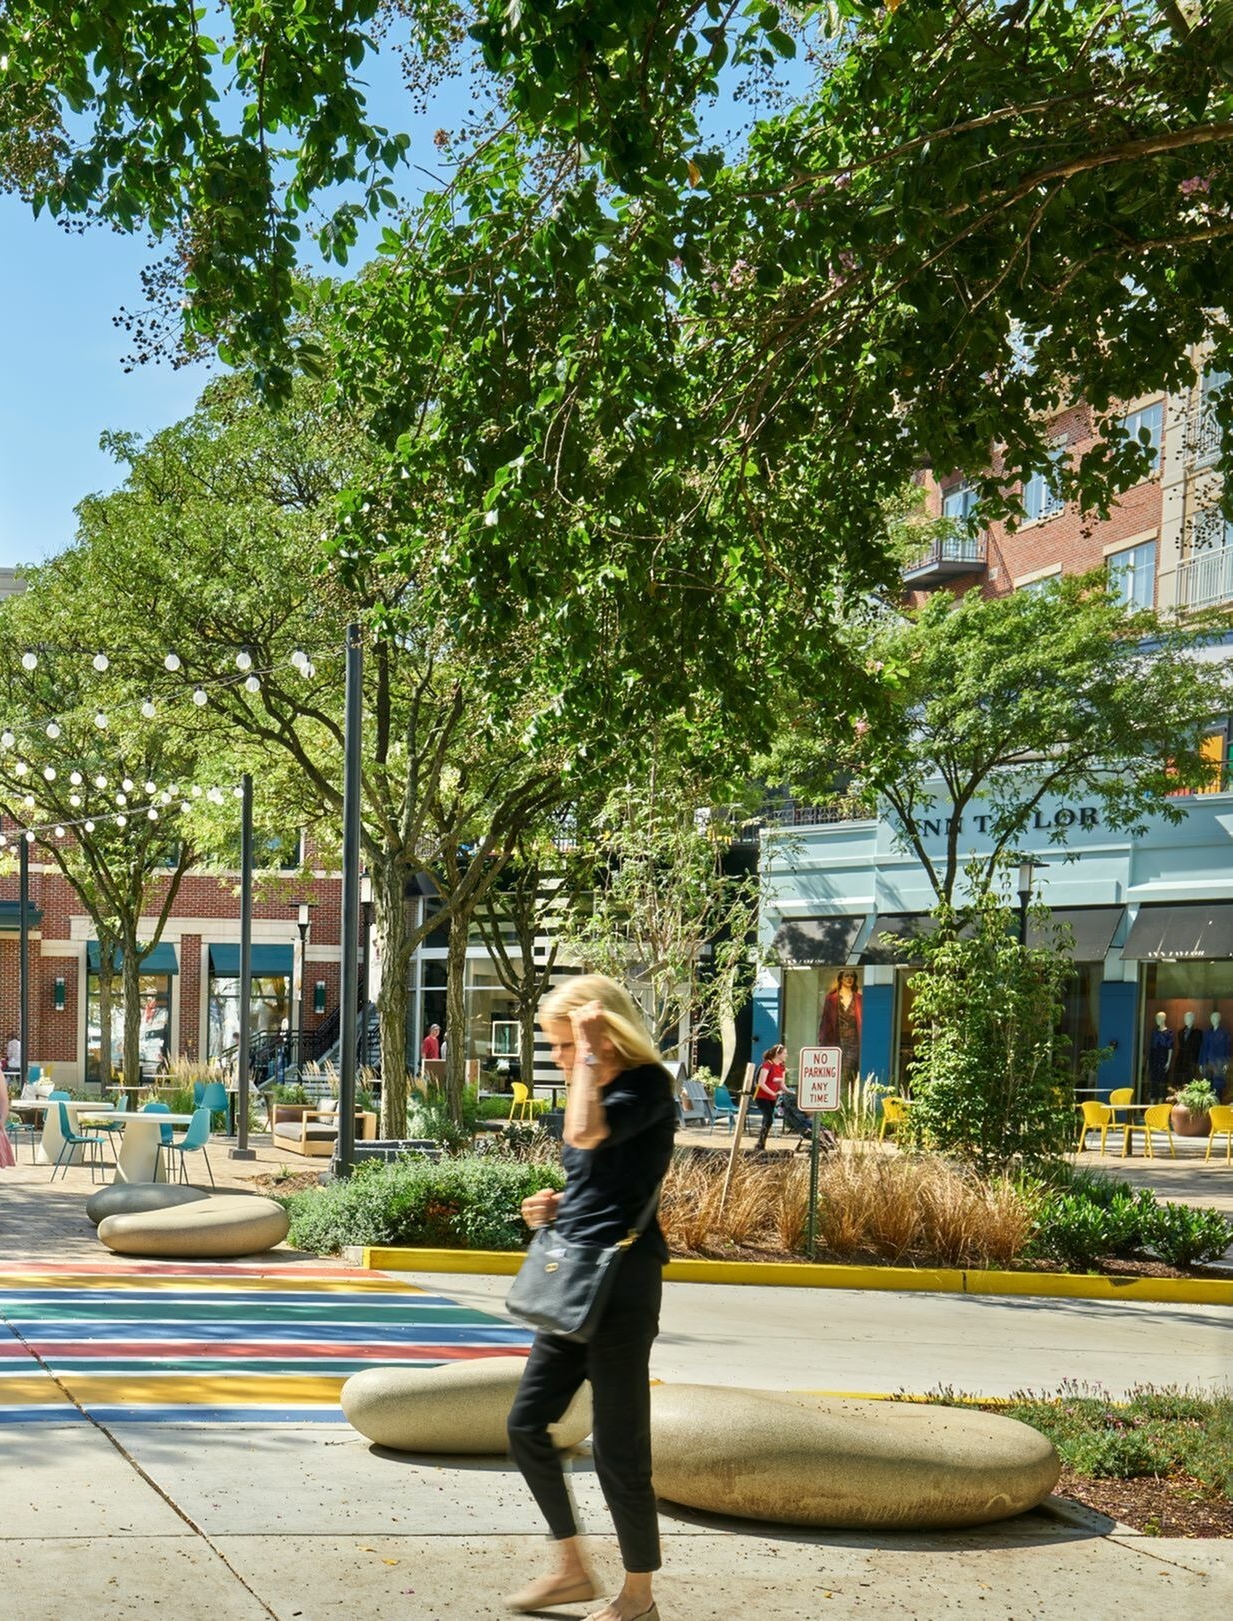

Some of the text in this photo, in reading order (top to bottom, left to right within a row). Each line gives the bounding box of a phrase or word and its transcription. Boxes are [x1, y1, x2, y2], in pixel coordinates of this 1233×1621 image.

[973, 806, 1101, 834] TLOR
[813, 1053, 828, 1065] NO
[803, 1066, 836, 1078] PARKING
[811, 1082, 828, 1092] ANY
[809, 1093, 829, 1103] TIME
